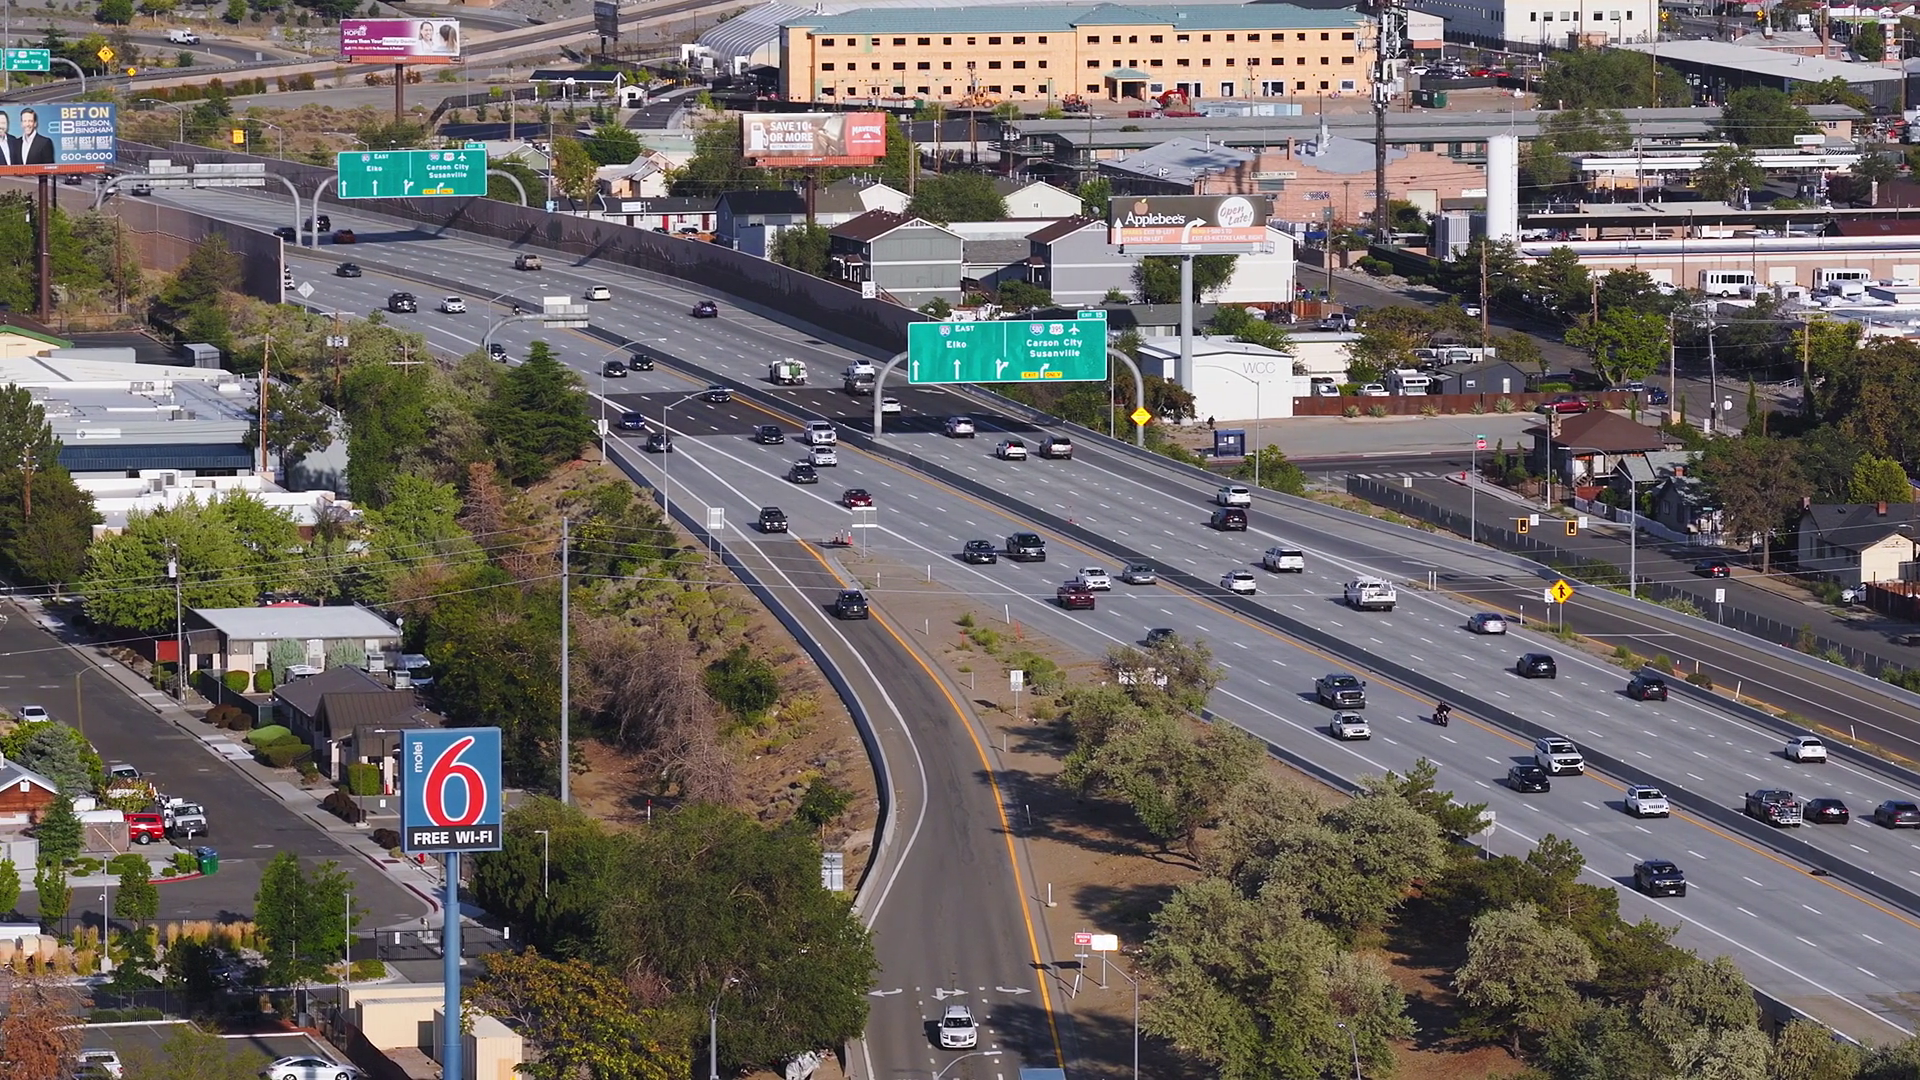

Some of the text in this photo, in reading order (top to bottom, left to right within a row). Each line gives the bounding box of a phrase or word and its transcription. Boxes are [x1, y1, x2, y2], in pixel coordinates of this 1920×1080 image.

[61, 106, 110, 118] BET ON
[770, 122, 794, 131] SAVE
[852, 126, 881, 136] MAVERIK
[770, 132, 813, 142] OR MORE
[61, 152, 113, 160] 600-6000
[454, 163, 469, 172] City
[1220, 206, 1244, 218] Open
[1125, 211, 1186, 227] Applebee's
[1228, 212, 1252, 225] Late!
[1063, 338, 1083, 348] City
[1243, 362, 1276, 374] WCC
[413, 742, 423, 773] motel
[423, 736, 488, 826] 6
[414, 830, 492, 845] FREE WI-FI
